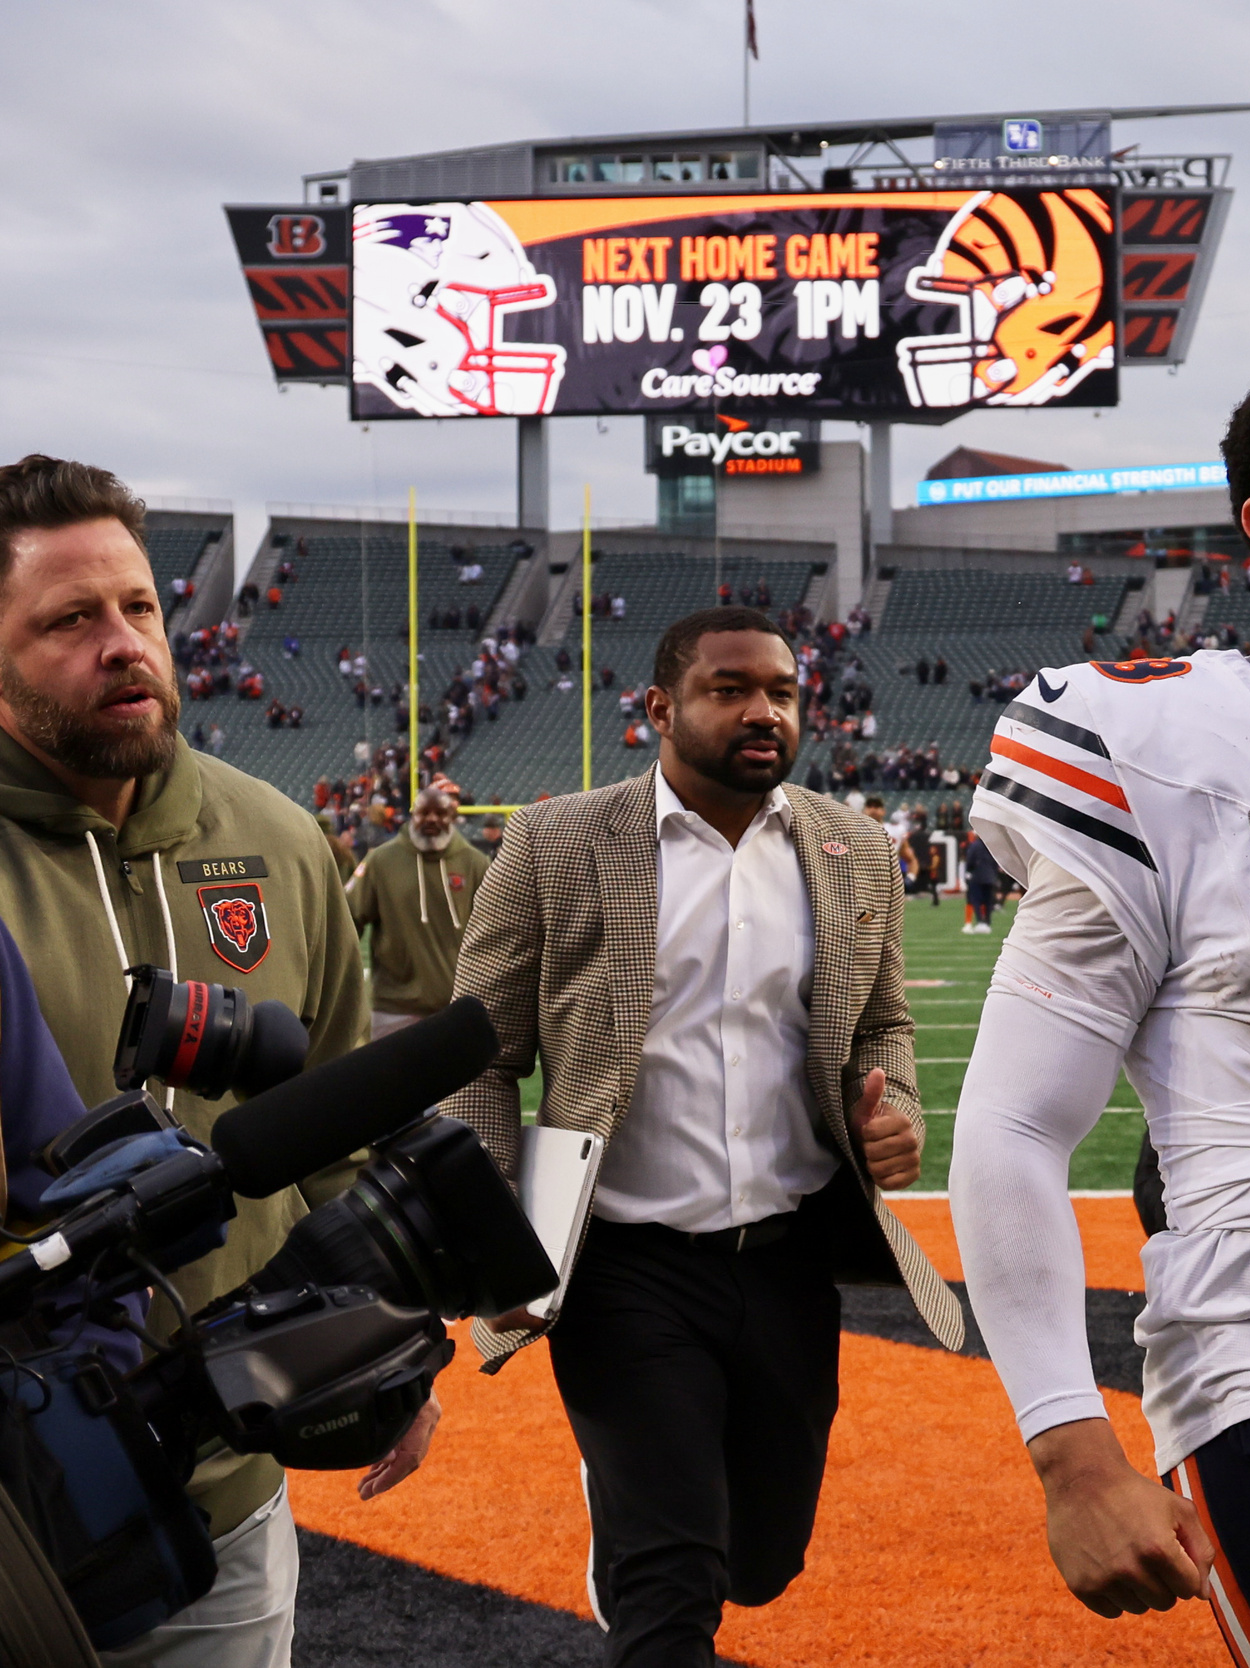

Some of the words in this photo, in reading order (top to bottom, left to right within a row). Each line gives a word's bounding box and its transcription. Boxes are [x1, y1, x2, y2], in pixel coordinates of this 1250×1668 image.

[942, 157, 990, 170] FIFTH
[996, 155, 1050, 169] THIRD
[1057, 154, 1105, 168] BANK
[582, 237, 673, 283] NEXT
[680, 235, 777, 281] HOME
[785, 232, 879, 279] GAME
[582, 283, 684, 344] NOV.
[698, 281, 762, 341] 23
[793, 279, 880, 339] 1PM
[641, 366, 821, 398] CareSource
[661, 425, 801, 464] Paycor
[726, 458, 802, 473] STADIUM
[953, 481, 982, 498] PUT
[986, 479, 1020, 496] OUR
[1024, 474, 1108, 493] FINANCIAL
[1111, 467, 1195, 487] STRENGTH
[202, 860, 246, 877] BEARS
[300, 1412, 360, 1439] Canon
